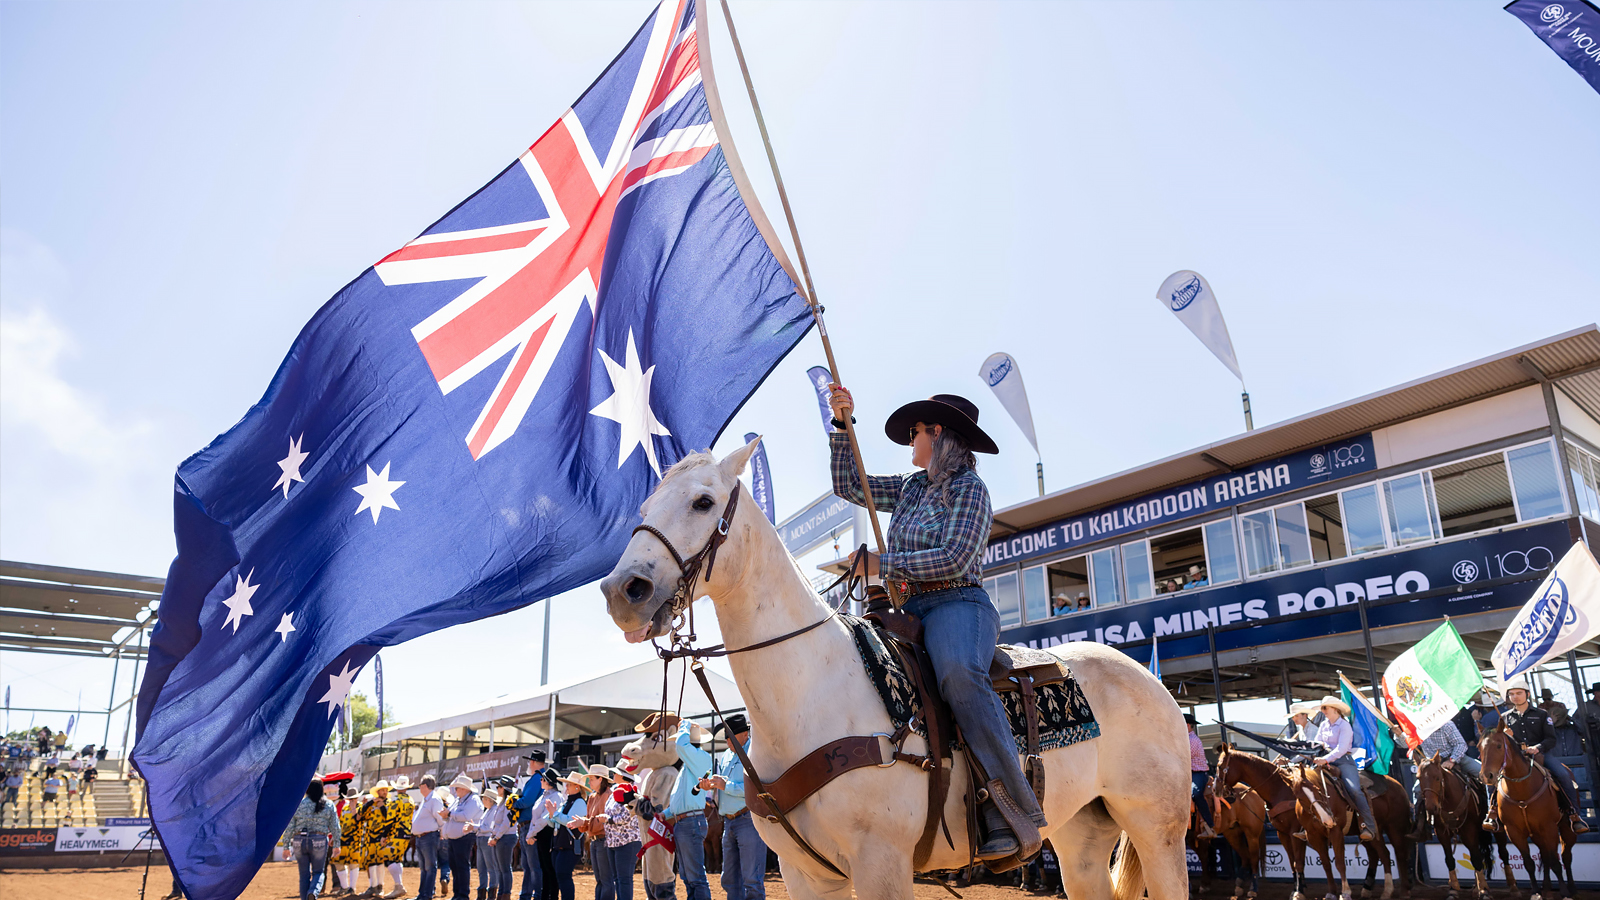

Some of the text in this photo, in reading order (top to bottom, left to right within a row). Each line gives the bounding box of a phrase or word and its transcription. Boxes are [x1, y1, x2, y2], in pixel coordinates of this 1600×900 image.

[1567, 27, 1600, 65] MOUN
[1333, 443, 1364, 463] 100
[1335, 456, 1366, 469] YEARS
[982, 463, 1291, 565] WELCOME TO KALKADOON ARENA
[1494, 546, 1554, 577] 100
[60, 840, 120, 849] HEAVYMECH
